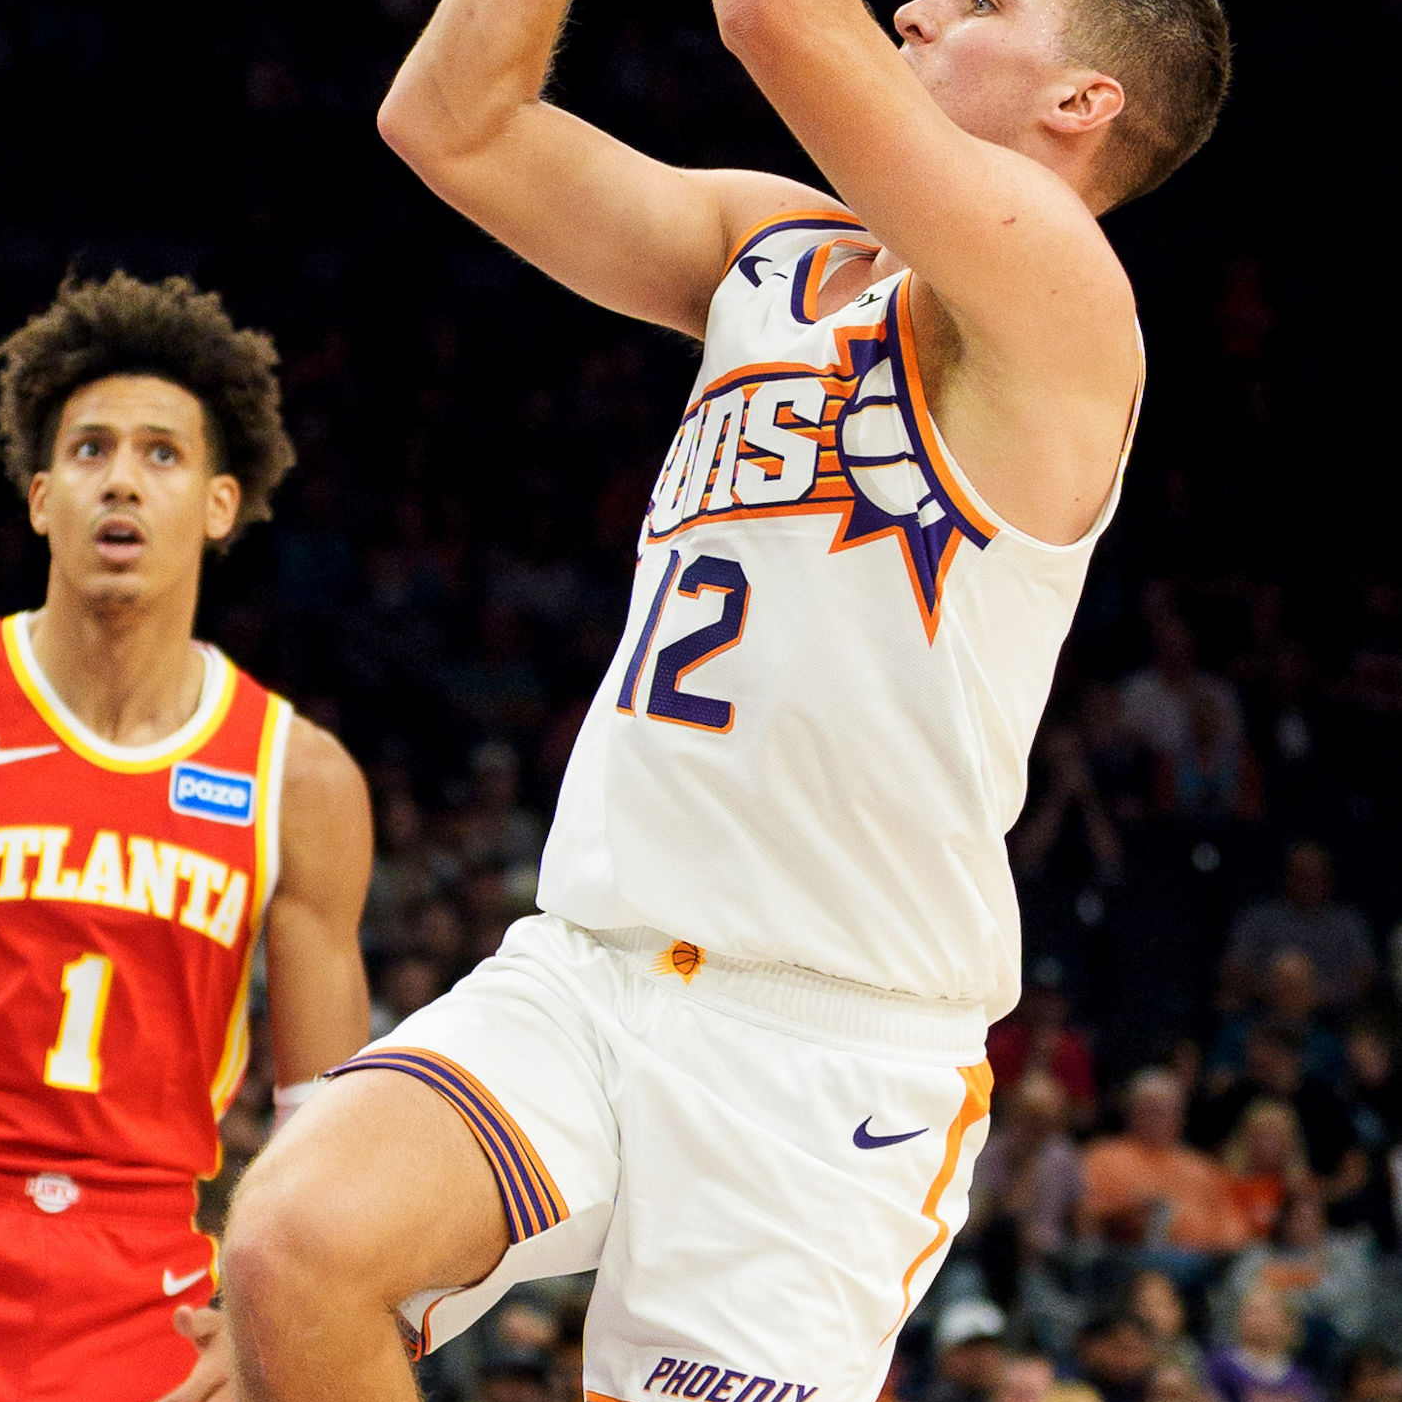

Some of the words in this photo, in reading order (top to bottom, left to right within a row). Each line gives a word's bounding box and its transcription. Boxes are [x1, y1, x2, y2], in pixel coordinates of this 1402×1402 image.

[648, 378, 827, 535] UNS
[615, 548, 751, 734] 12
[177, 775, 248, 808] paze
[44, 953, 113, 1093] 1
